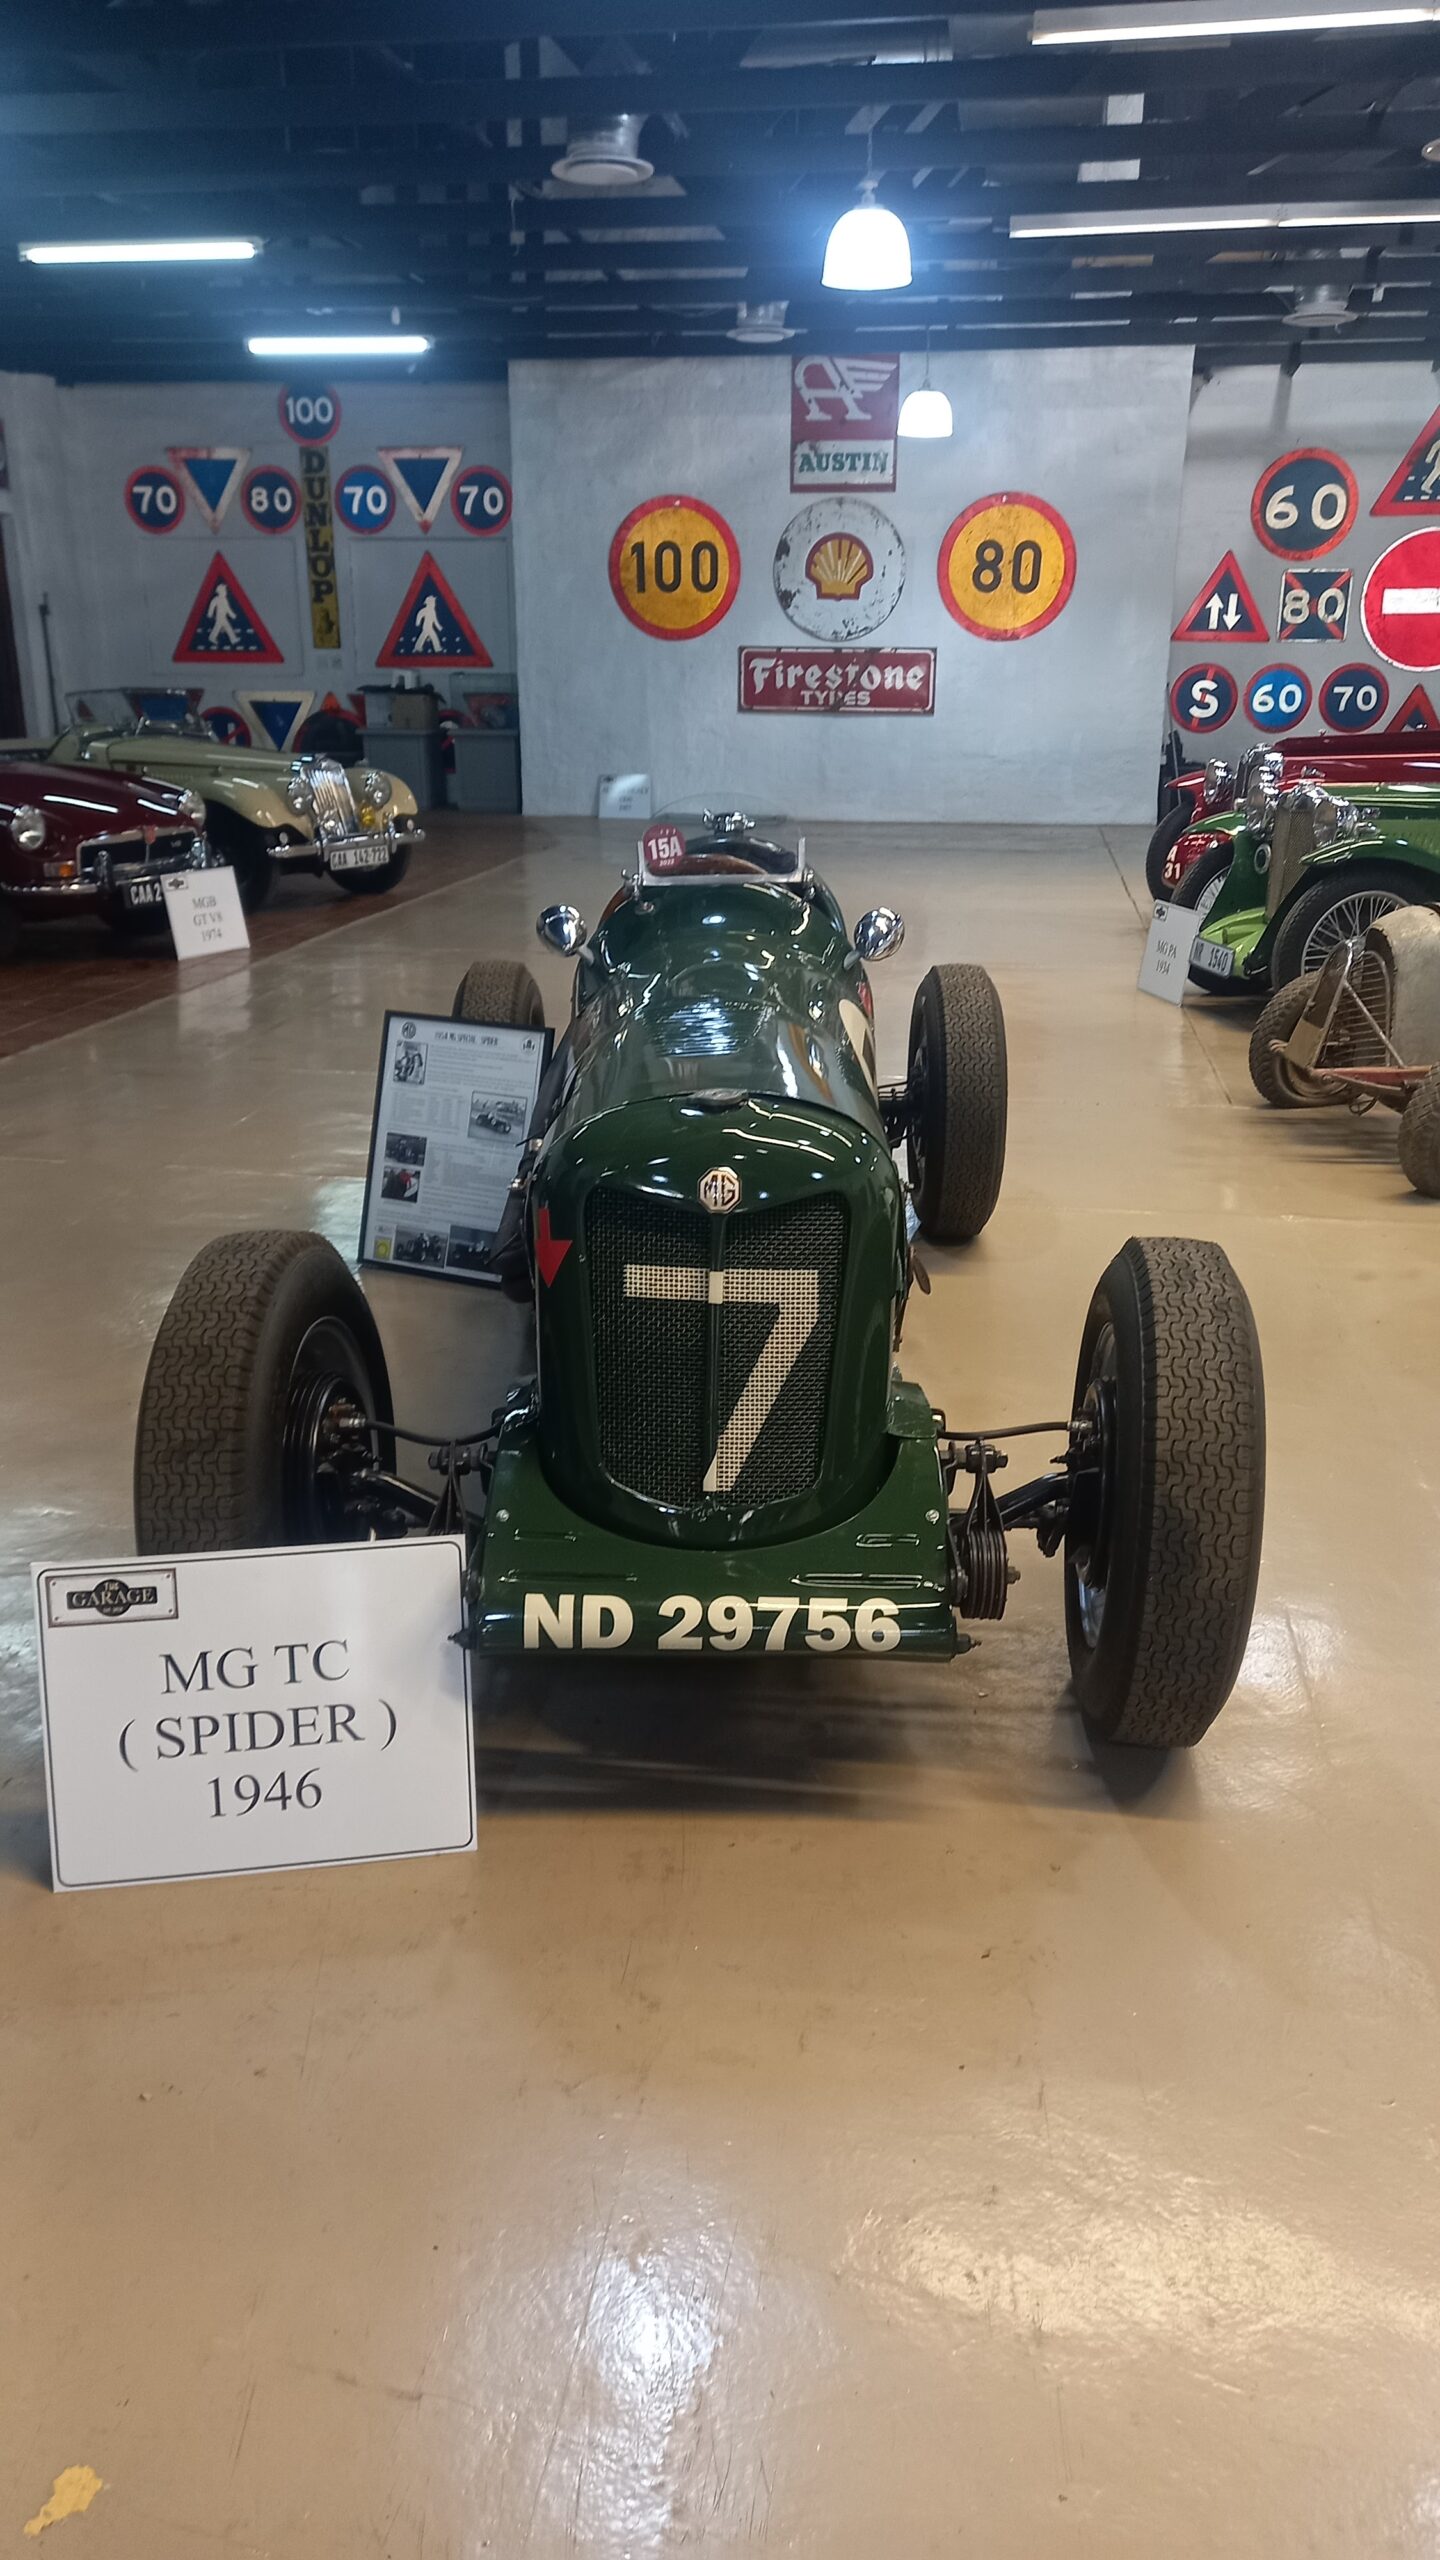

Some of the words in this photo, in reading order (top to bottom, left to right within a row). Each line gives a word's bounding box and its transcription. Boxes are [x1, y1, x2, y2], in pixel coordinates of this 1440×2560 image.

[286, 396, 334, 425] 100
[799, 452, 888, 473] AUSTIN
[132, 485, 177, 515] 70
[250, 486, 293, 513] 80
[343, 485, 388, 515] 70
[458, 485, 504, 516] 70
[1265, 483, 1347, 531] 60
[303, 452, 334, 603] DUNLOP
[631, 540, 719, 595] 100
[970, 539, 1043, 595] 80
[1283, 587, 1346, 625] 80
[749, 657, 926, 695] Firestone
[1188, 679, 1219, 719] S
[1252, 683, 1303, 714] 60
[1332, 685, 1378, 713] 70
[648, 836, 682, 860] 15A
[1167, 845, 1178, 862] A
[1164, 862, 1181, 880] 31
[130, 884, 153, 905] CAA
[192, 896, 217, 909] MGB
[193, 914, 208, 926] GT
[1208, 947, 1229, 972] 1540
[704, 1175, 735, 1207] MG
[623, 1264, 820, 1492] 7
[72, 1588, 154, 1607] GARAGE
[523, 1593, 634, 1650] ND
[657, 1595, 901, 1652] 29756
[160, 1647, 258, 1694] MG
[274, 1639, 350, 1685] TC
[207, 1768, 323, 1818] 1946
